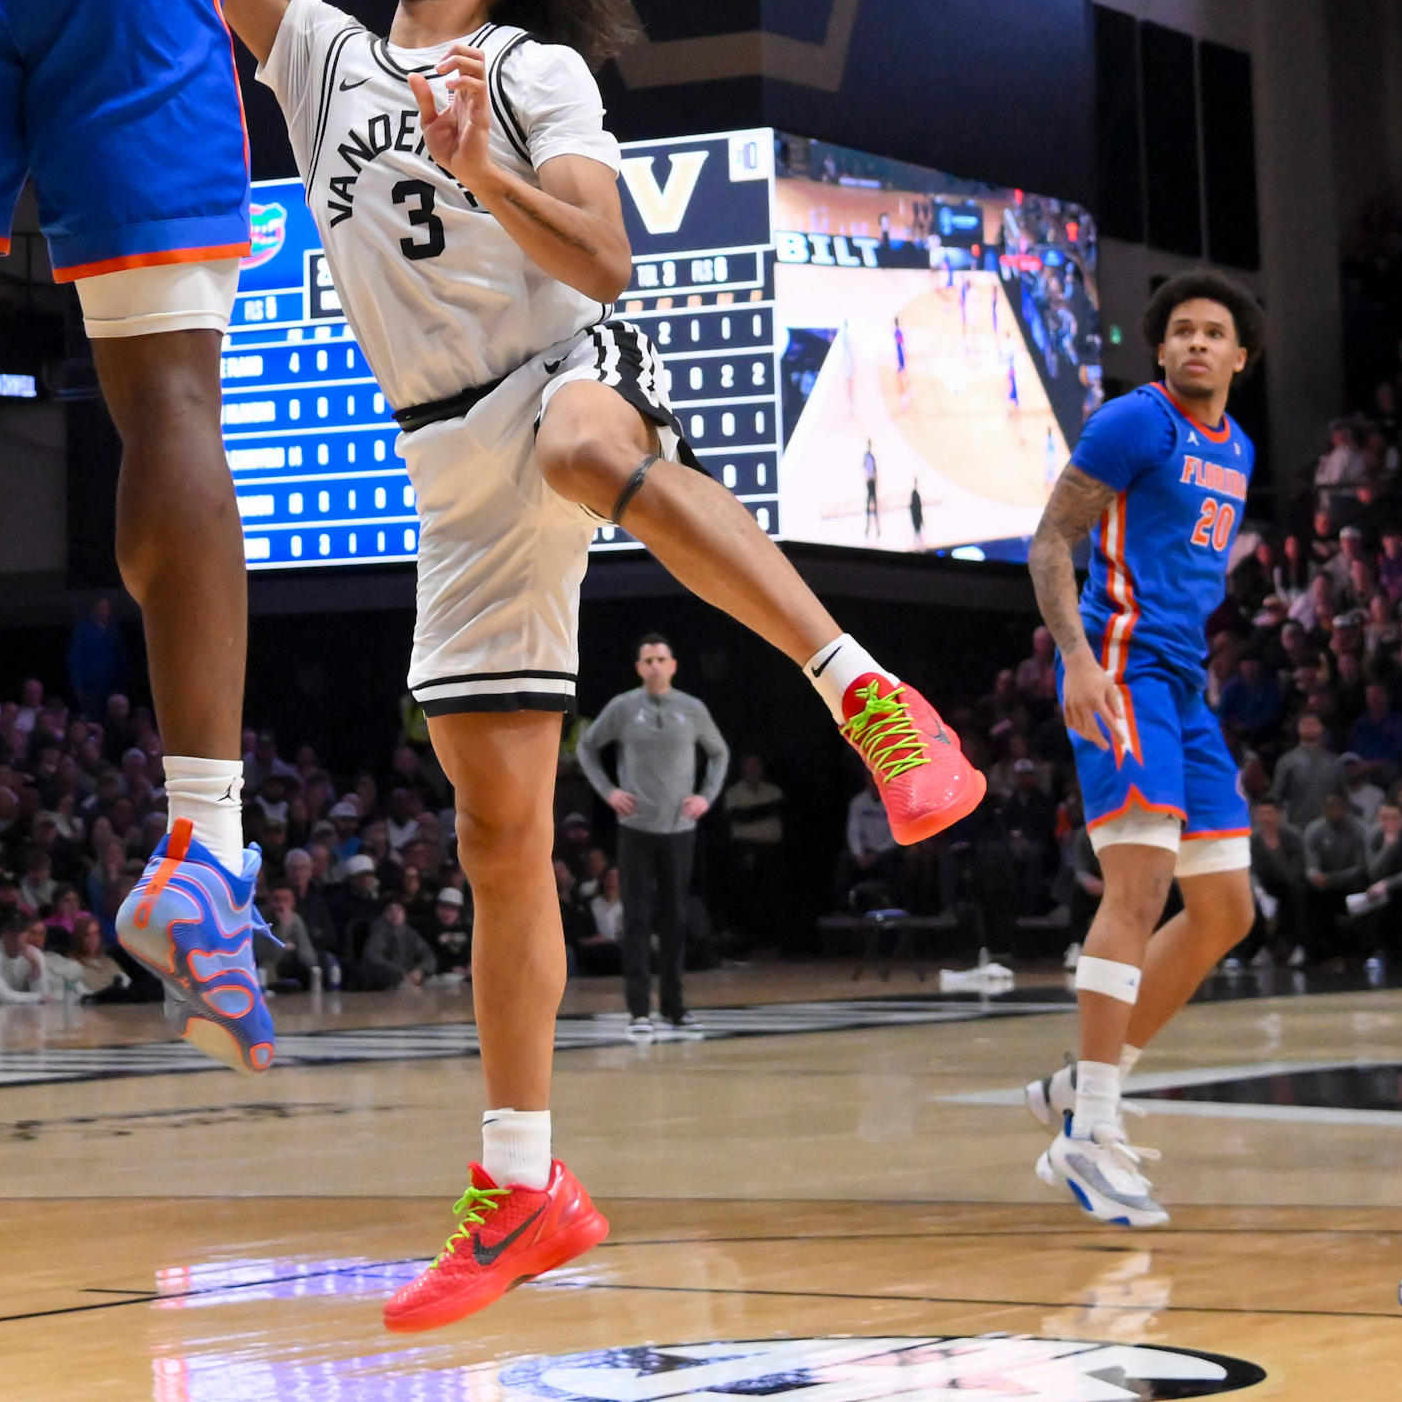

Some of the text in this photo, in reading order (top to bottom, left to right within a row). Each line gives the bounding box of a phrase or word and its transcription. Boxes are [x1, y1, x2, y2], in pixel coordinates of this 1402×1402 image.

[392, 178, 446, 261] 3
[620, 150, 709, 235] V
[1179, 454, 1248, 503] FLORIDA
[1190, 497, 1236, 551] 20
